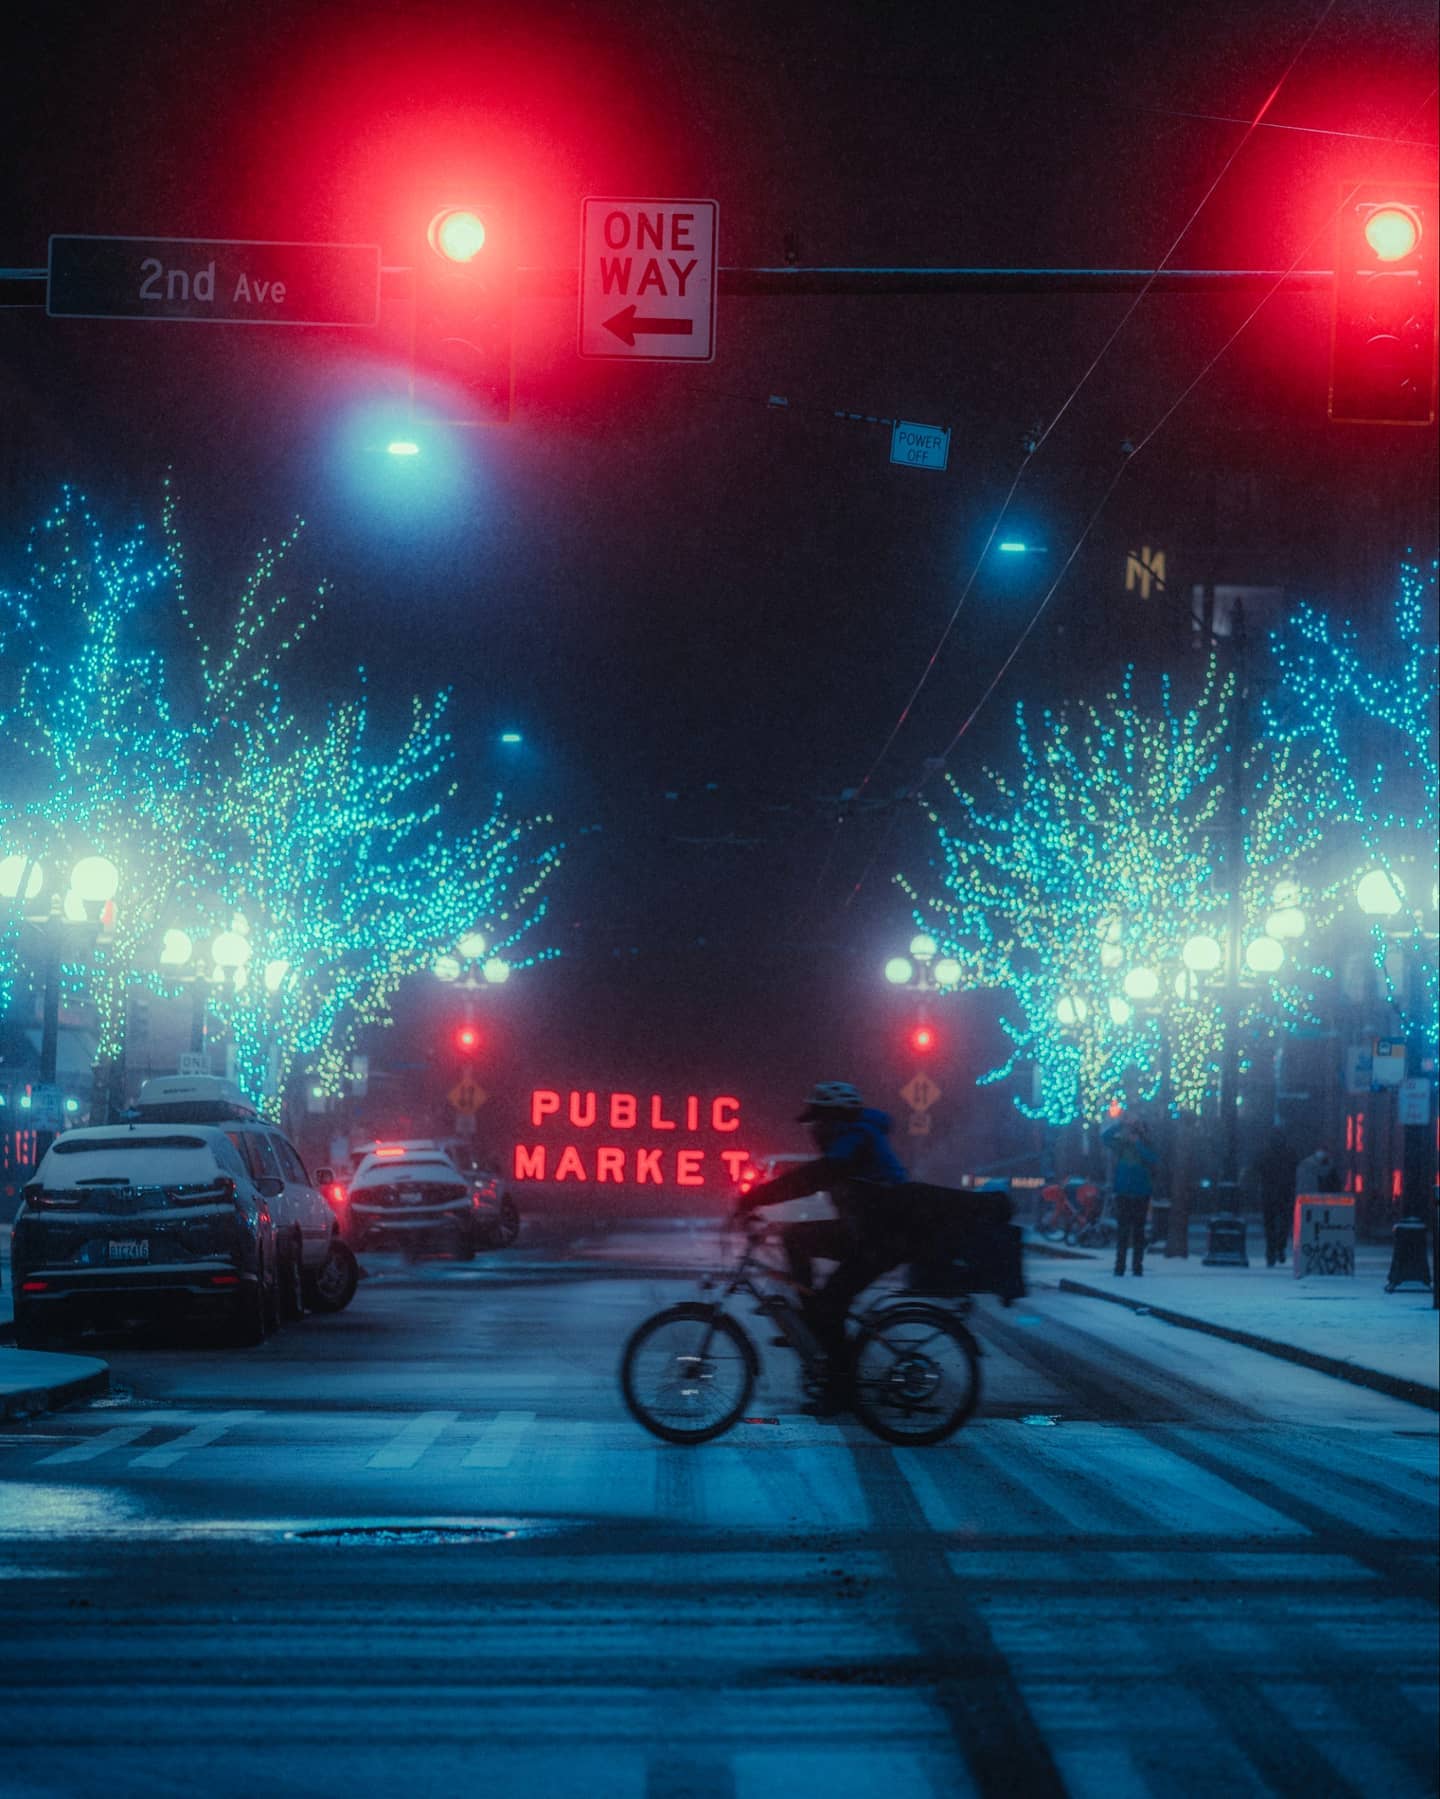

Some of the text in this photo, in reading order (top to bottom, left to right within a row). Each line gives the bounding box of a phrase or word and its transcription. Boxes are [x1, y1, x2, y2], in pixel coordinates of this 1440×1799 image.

[604, 210, 696, 252] ONE
[138, 256, 287, 304] 2nd Ave
[600, 256, 699, 297] WAY
[898, 431, 942, 449] POWER
[907, 448, 929, 464] OFF
[532, 1090, 741, 1132] PUBLIC
[514, 1144, 751, 1186] MARKET
